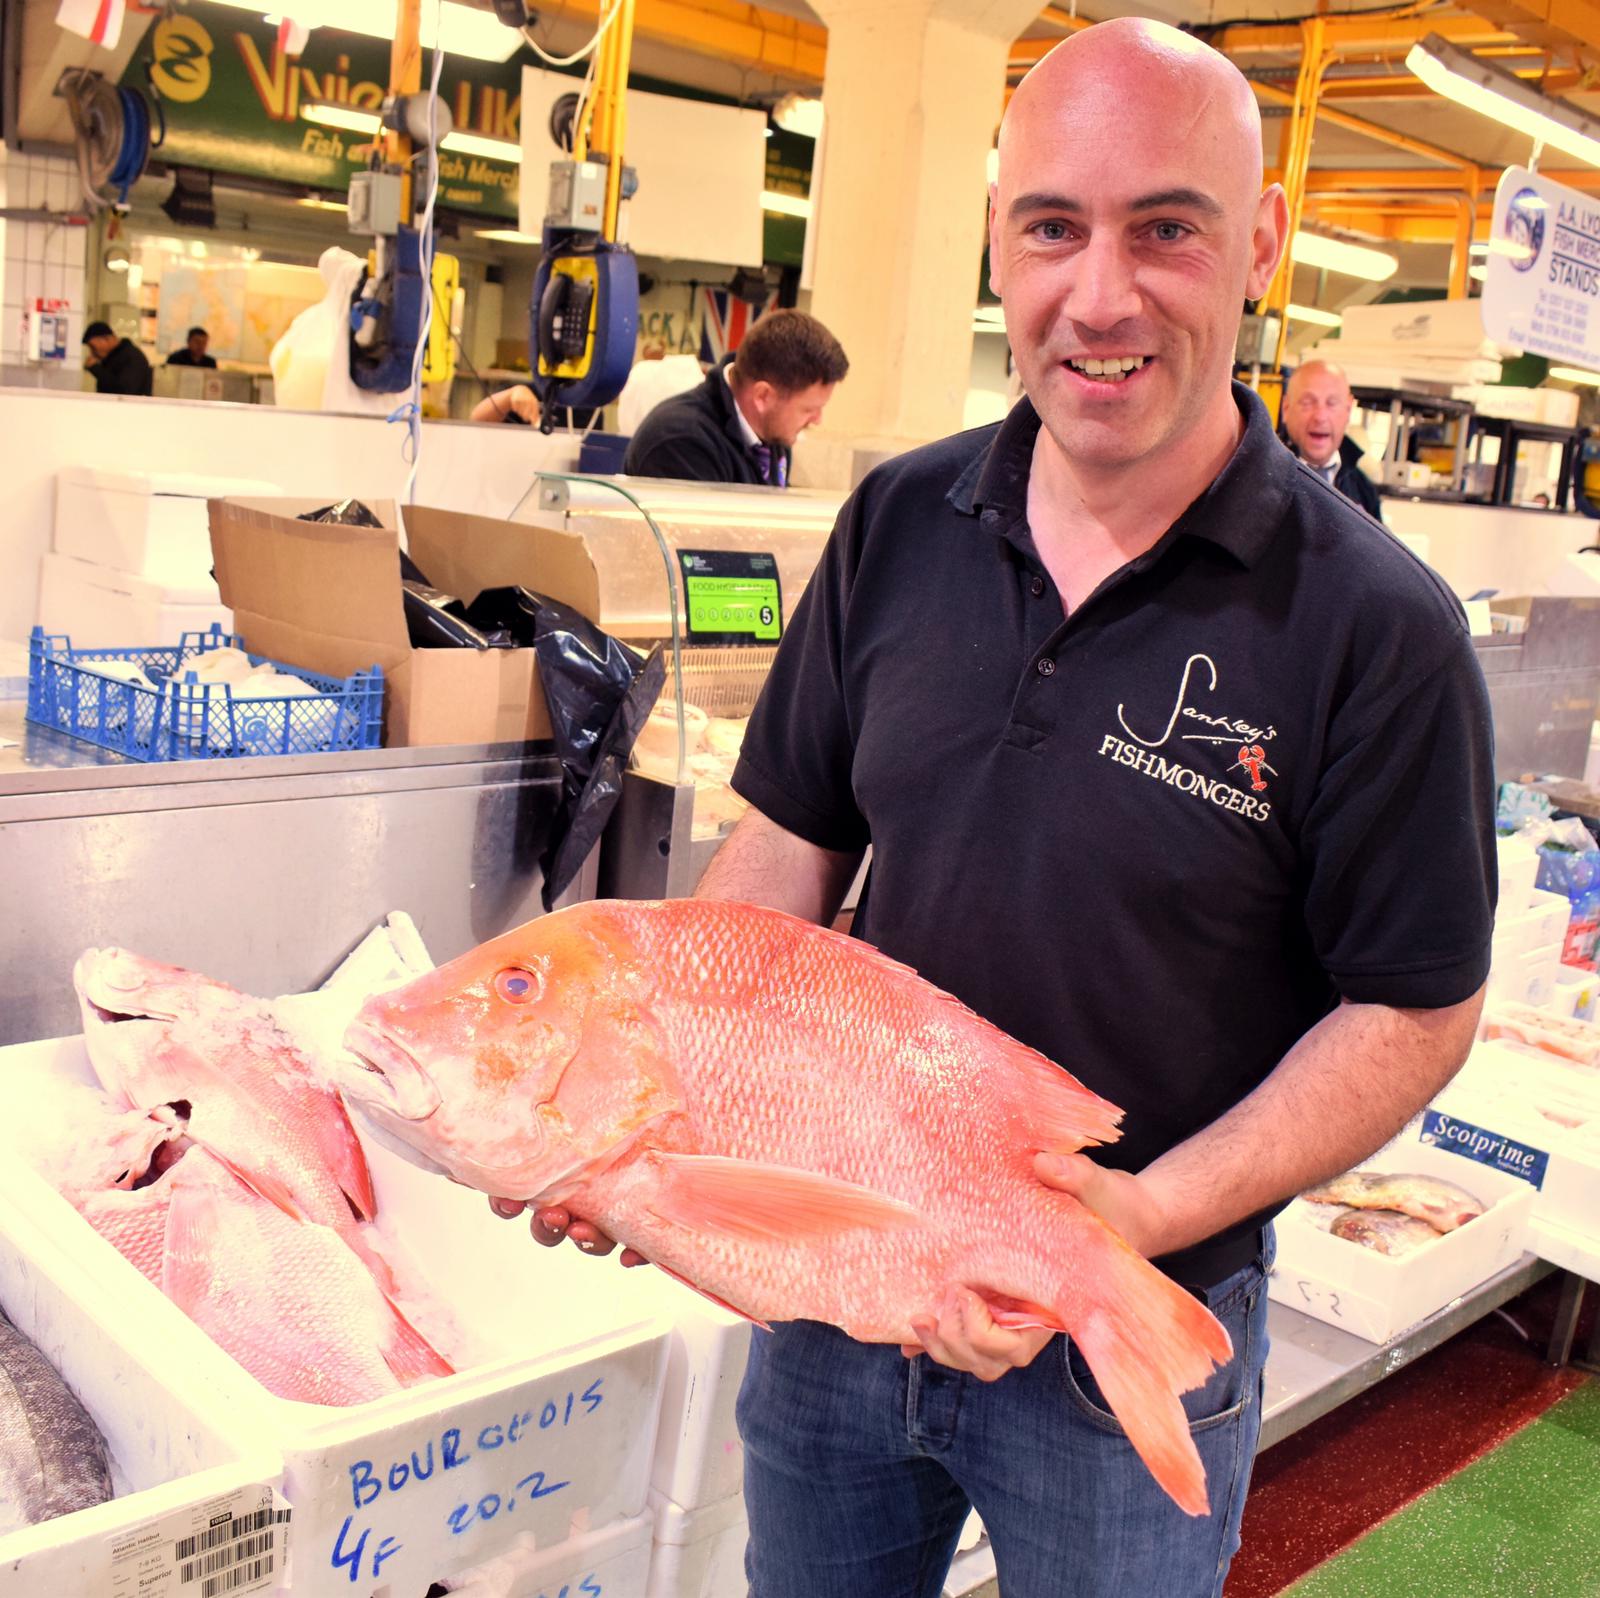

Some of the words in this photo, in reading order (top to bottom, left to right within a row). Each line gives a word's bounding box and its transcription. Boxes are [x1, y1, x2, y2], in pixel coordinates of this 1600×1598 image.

[302, 128, 344, 159] Fish
[1553, 231, 1575, 252] FISH
[1549, 258, 1599, 297] STANDS
[762, 607, 771, 625] 5
[1098, 734, 1272, 822] FISHMONGERS
[1434, 1115, 1535, 1169] Scotprime
[138, 1569, 173, 1588] Superior
